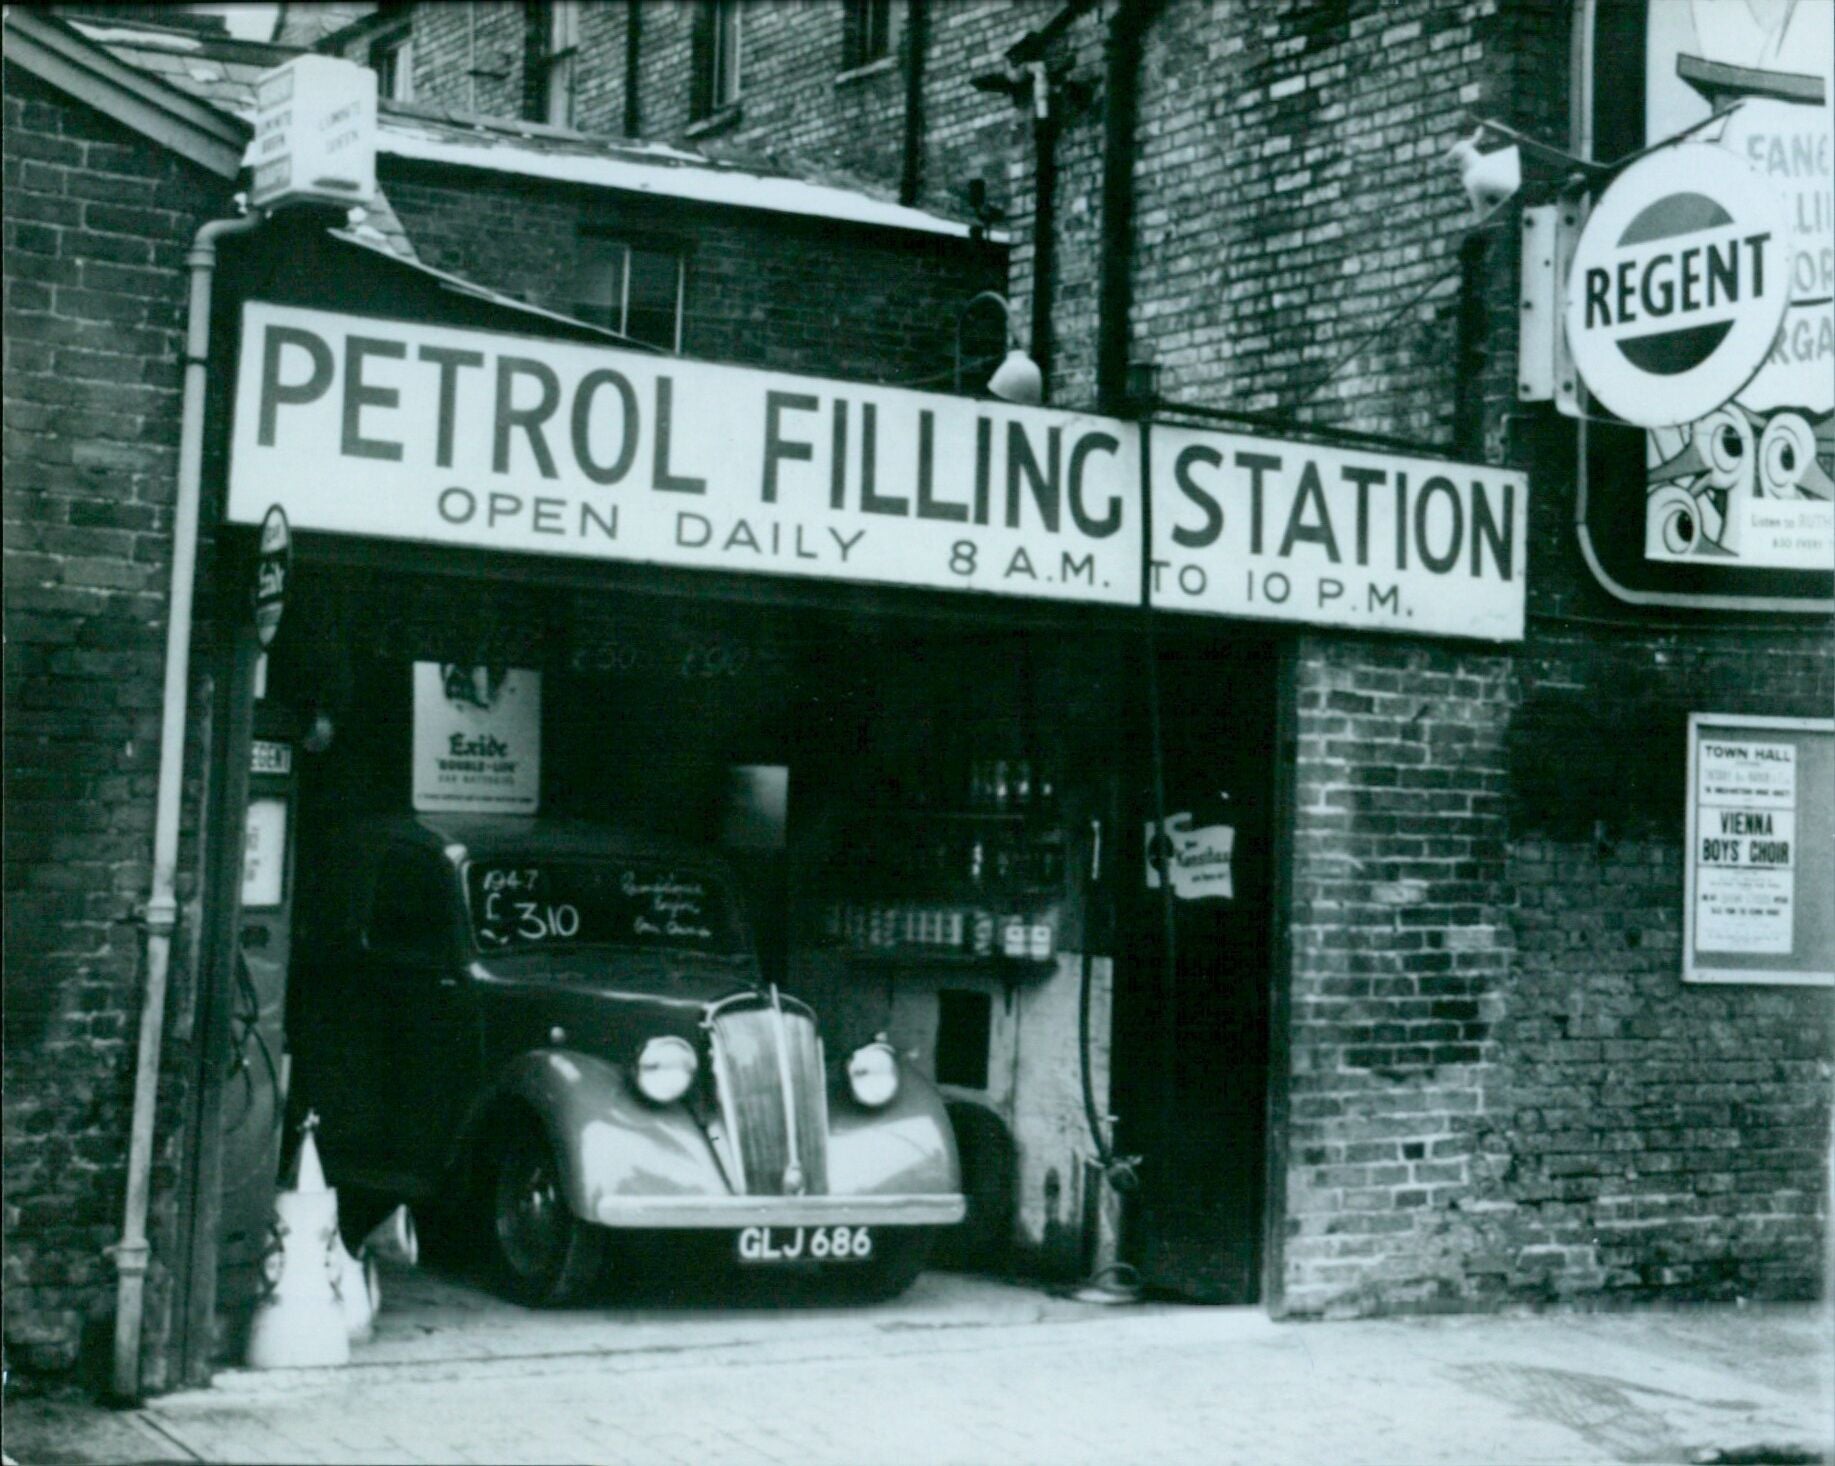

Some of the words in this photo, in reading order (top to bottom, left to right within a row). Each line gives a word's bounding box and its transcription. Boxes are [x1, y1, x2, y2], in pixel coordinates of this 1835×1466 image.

[1585, 231, 1772, 330] REGENT
[257, 323, 707, 495] PETROL
[761, 389, 1122, 538] FILLING
[1171, 444, 1515, 582] STATION
[437, 486, 619, 539] OPEN
[675, 511, 866, 562] DAILY
[948, 539, 977, 576] 8
[1003, 547, 1111, 588] A.M.
[1150, 560, 1207, 596] TO
[1247, 570, 1291, 604] 10
[1318, 577, 1414, 617] P.M.
[449, 732, 508, 758] Exide
[1705, 745, 1748, 760] TOWN
[1755, 748, 1791, 763] HALL
[1720, 811, 1774, 836] VIENNA
[1749, 840, 1790, 864] CHOIR
[482, 868, 539, 892] 1947
[739, 1226, 804, 1259] GLJ
[810, 1226, 872, 1258] 686
